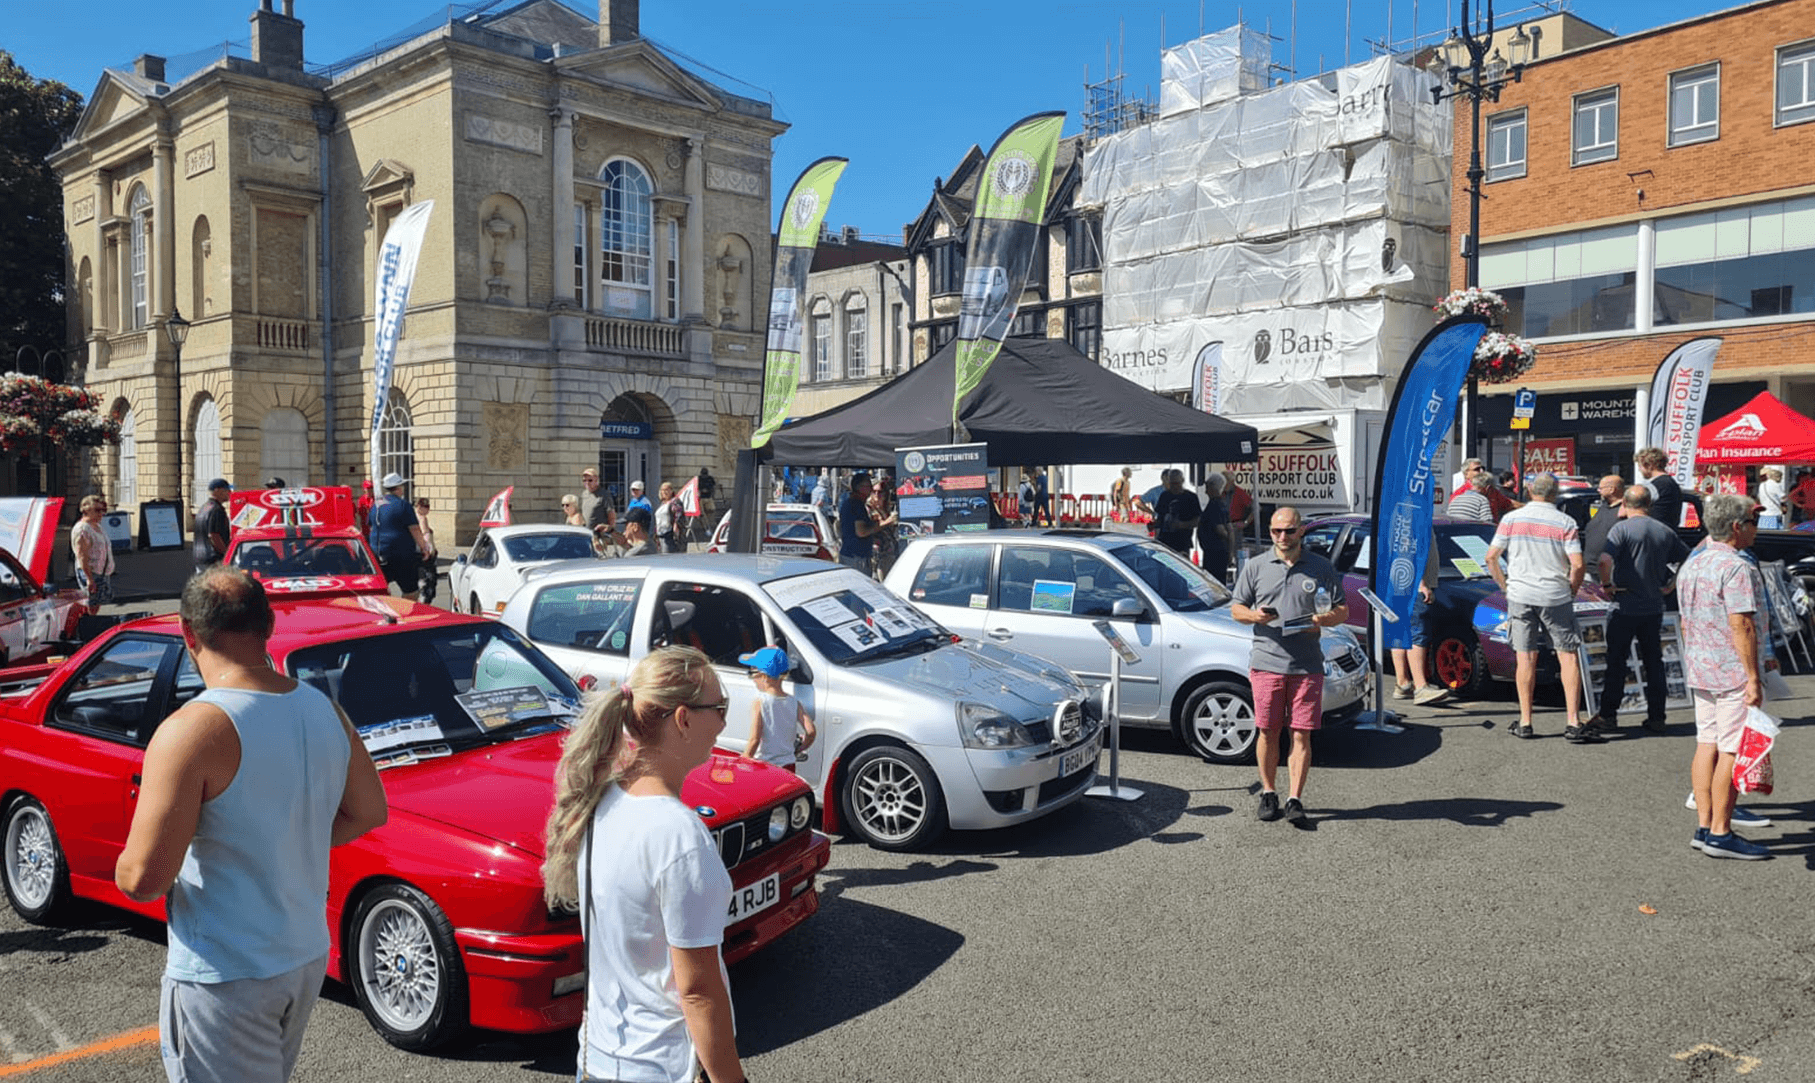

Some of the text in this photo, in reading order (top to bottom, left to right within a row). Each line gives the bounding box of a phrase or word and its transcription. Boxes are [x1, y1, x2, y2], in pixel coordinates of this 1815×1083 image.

[383, 285, 408, 340] CLUB
[1520, 391, 1533, 406] P
[1582, 399, 1636, 409] MOUNTA
[1582, 410, 1636, 418] WAREHO
[1666, 367, 1694, 477] EST SUFFOLK
[1677, 370, 1704, 486] OTORSPORT CLUB
[926, 452, 980, 463] OPPORTUNITIES
[1722, 446, 1782, 458] Insurance
[1269, 454, 1338, 471] SUFFOLK
[1235, 472, 1336, 485] OTORSPORT CLUB
[1400, 517, 1412, 552] sport
[762, 545, 813, 553] ONSTRUCTION
[743, 878, 776, 913] RJB
